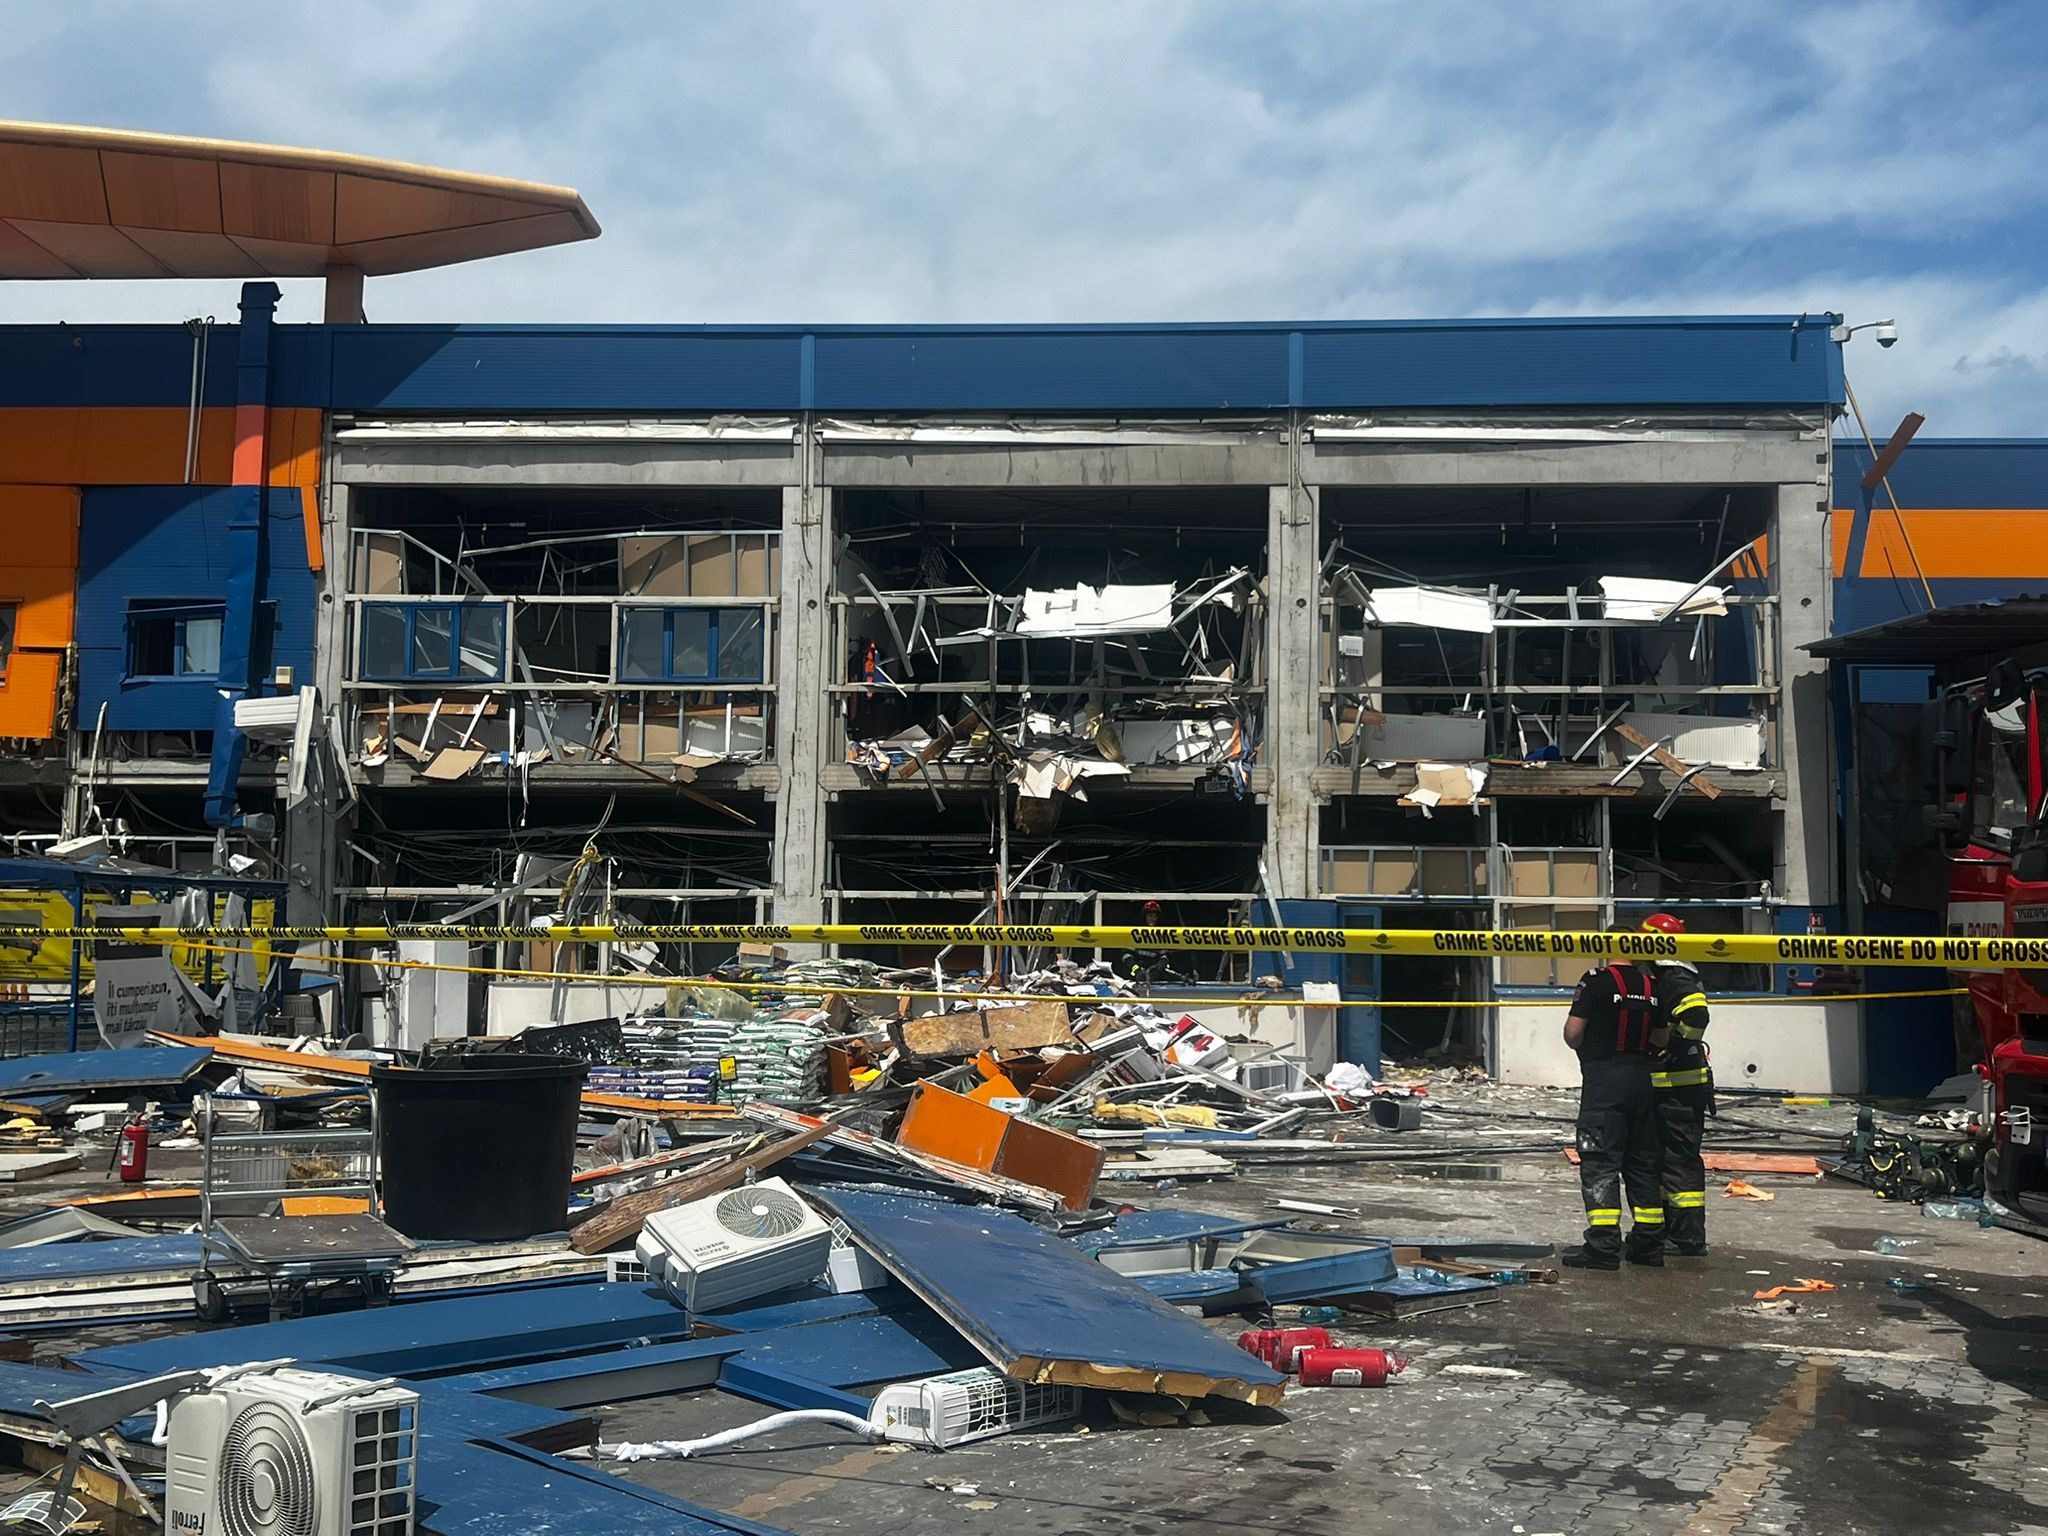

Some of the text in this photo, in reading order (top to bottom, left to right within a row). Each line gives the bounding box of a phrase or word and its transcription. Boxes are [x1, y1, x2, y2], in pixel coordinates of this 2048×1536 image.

[386, 927, 551, 938] CRIME SCENE DO NOT CROSS
[613, 926, 792, 938] CRIME SCENE DO NOT CROSS
[860, 926, 1054, 941] CRIME SCENE DO NOT CROSS
[1131, 929, 1346, 948] CRIME SCENE DO NOT CROSS
[1434, 932, 1677, 955] CRIME SCENE DO NOT CROSS
[1778, 938, 1838, 959] CRIME
[1844, 938, 1904, 960] SCENE
[1912, 940, 1937, 961] DO
[1943, 940, 1981, 961] NOT
[172, 1510, 205, 1535] Ferroli
